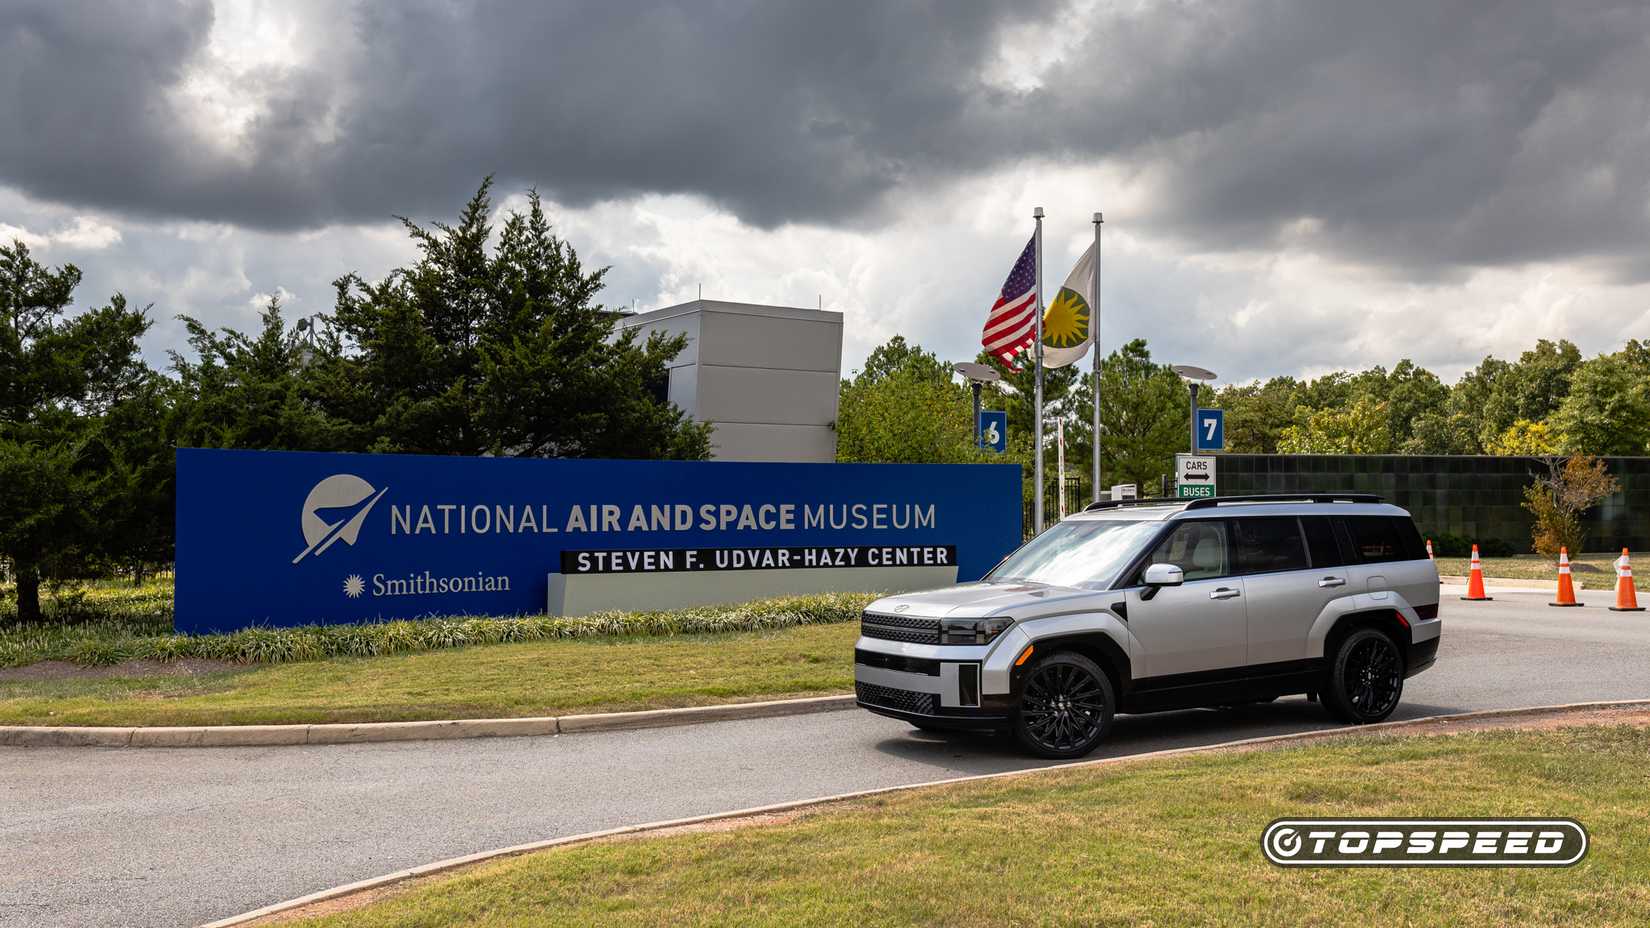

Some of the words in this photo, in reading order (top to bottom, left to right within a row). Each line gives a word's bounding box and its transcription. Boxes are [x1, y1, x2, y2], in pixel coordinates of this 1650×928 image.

[987, 421, 1000, 444] 6
[1203, 418, 1217, 441] 7
[1185, 460, 1208, 471] CARS
[1183, 487, 1211, 497] BUSES
[390, 504, 558, 535] NATIONAL
[565, 504, 622, 533] AIR
[627, 504, 694, 532] AND
[699, 503, 796, 530] SPACE
[803, 503, 936, 529] MUSEUM
[577, 551, 674, 572] STEVEN
[685, 550, 704, 570] F.
[715, 547, 859, 568] UDVAR-HAZY
[867, 546, 949, 566] CENTER
[372, 571, 511, 597] Smithsonian
